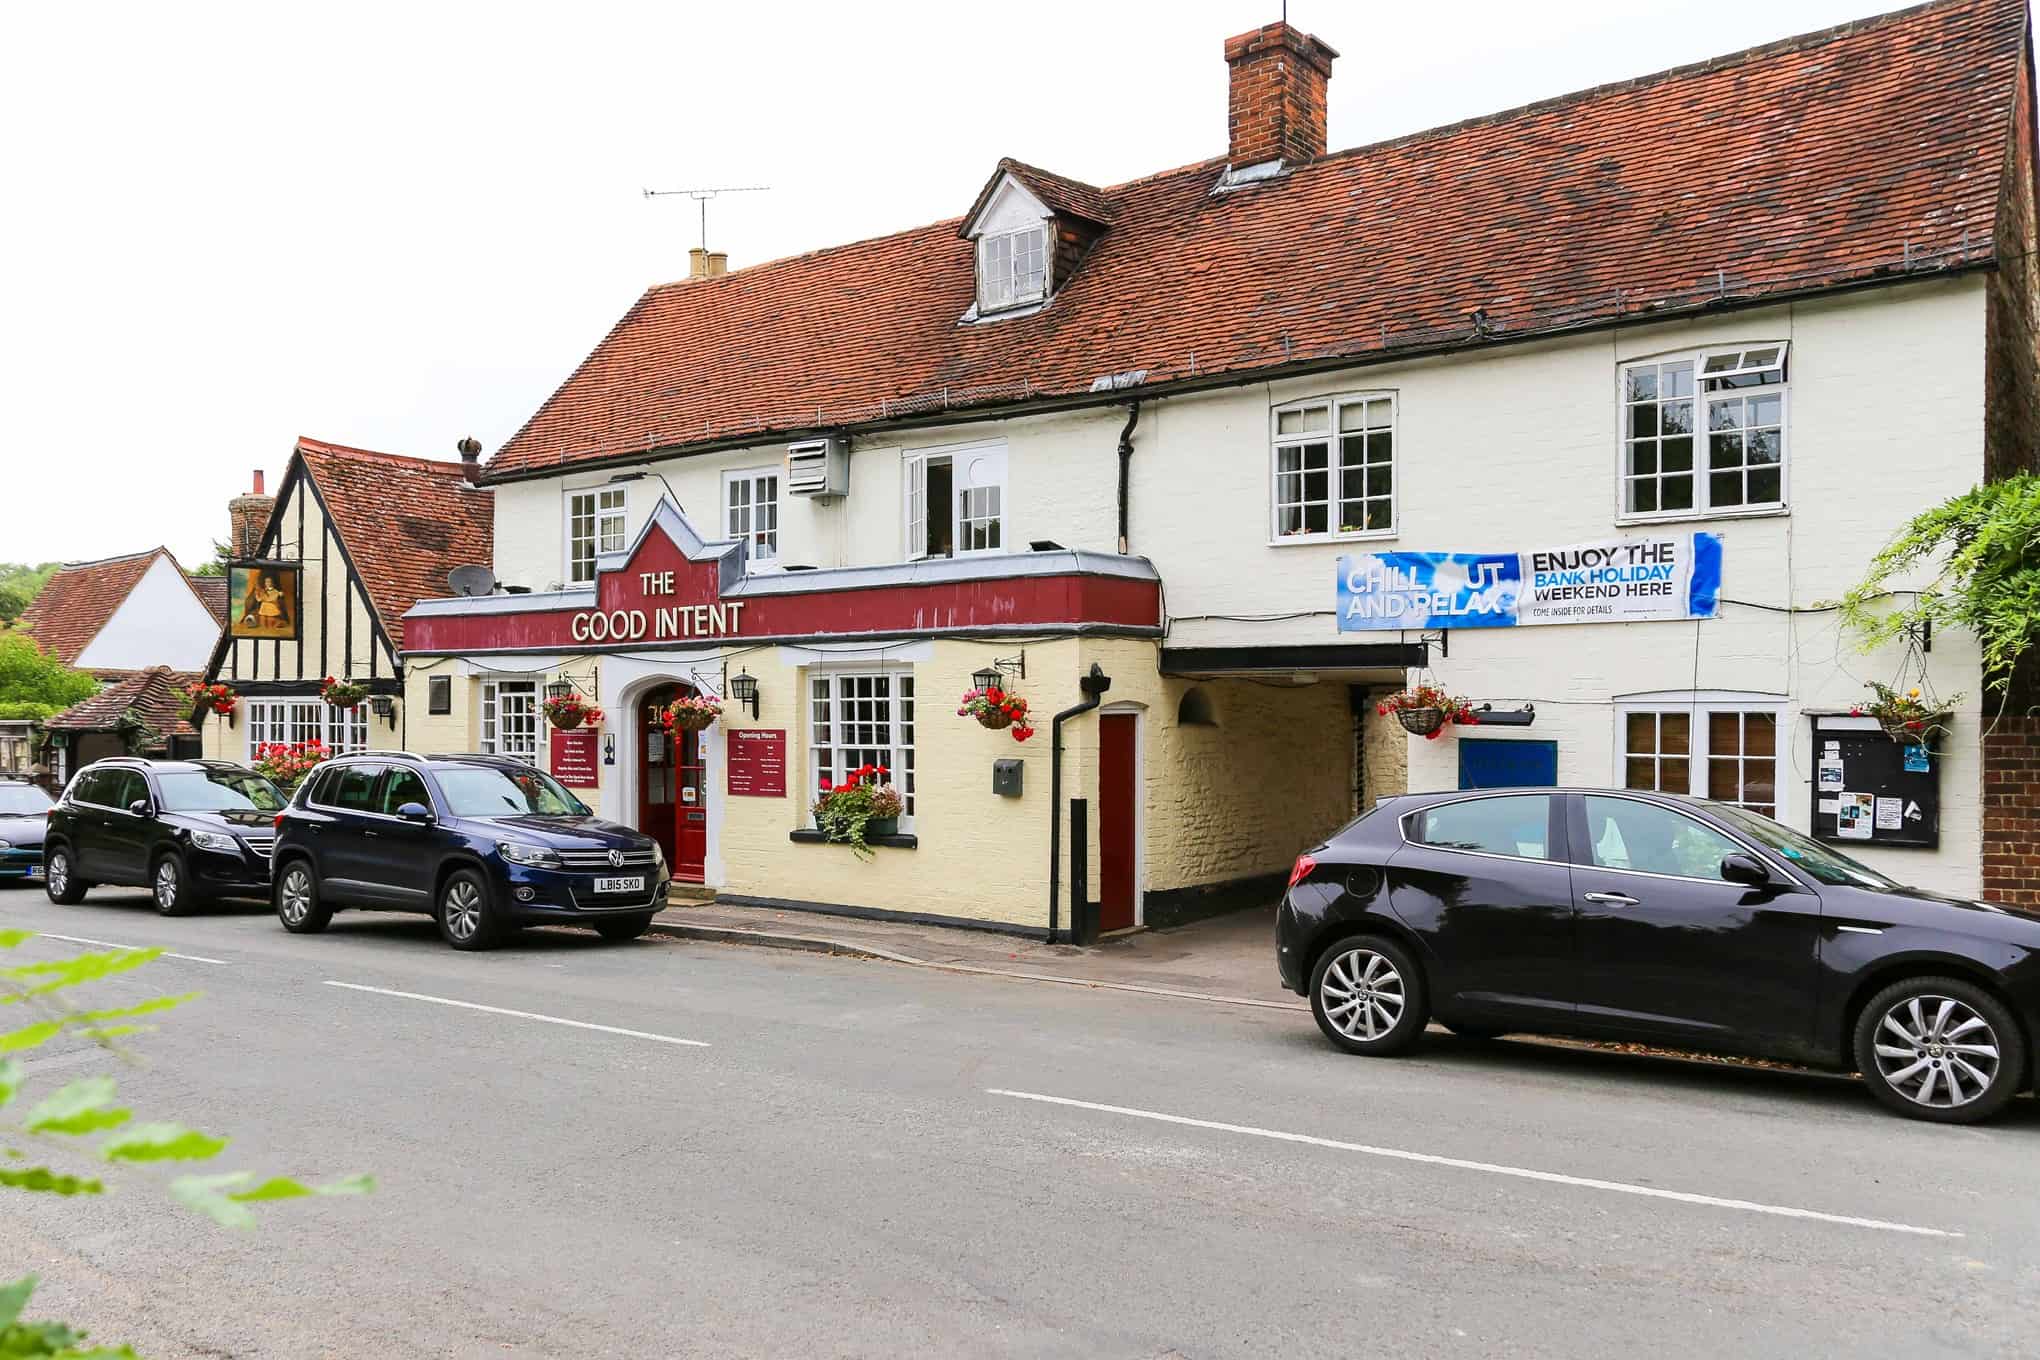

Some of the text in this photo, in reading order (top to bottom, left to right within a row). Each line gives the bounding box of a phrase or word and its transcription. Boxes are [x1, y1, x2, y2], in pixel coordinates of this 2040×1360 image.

[1533, 543, 1675, 571] ENJOY THE
[640, 571, 675, 595] THE
[1347, 566, 1426, 594] CHILL
[1535, 564, 1674, 587] BANK HOLIDAY
[1535, 582, 1673, 601] WEEKEND HERE
[1346, 592, 1505, 619] AND RELAX
[1533, 607, 1550, 616] COME
[1551, 606, 1572, 616] INSIDE
[1573, 606, 1585, 615] FOR
[1586, 604, 1613, 615] DETAILS
[572, 602, 744, 641] GOOD INTENT
[738, 731, 760, 740] Opening
